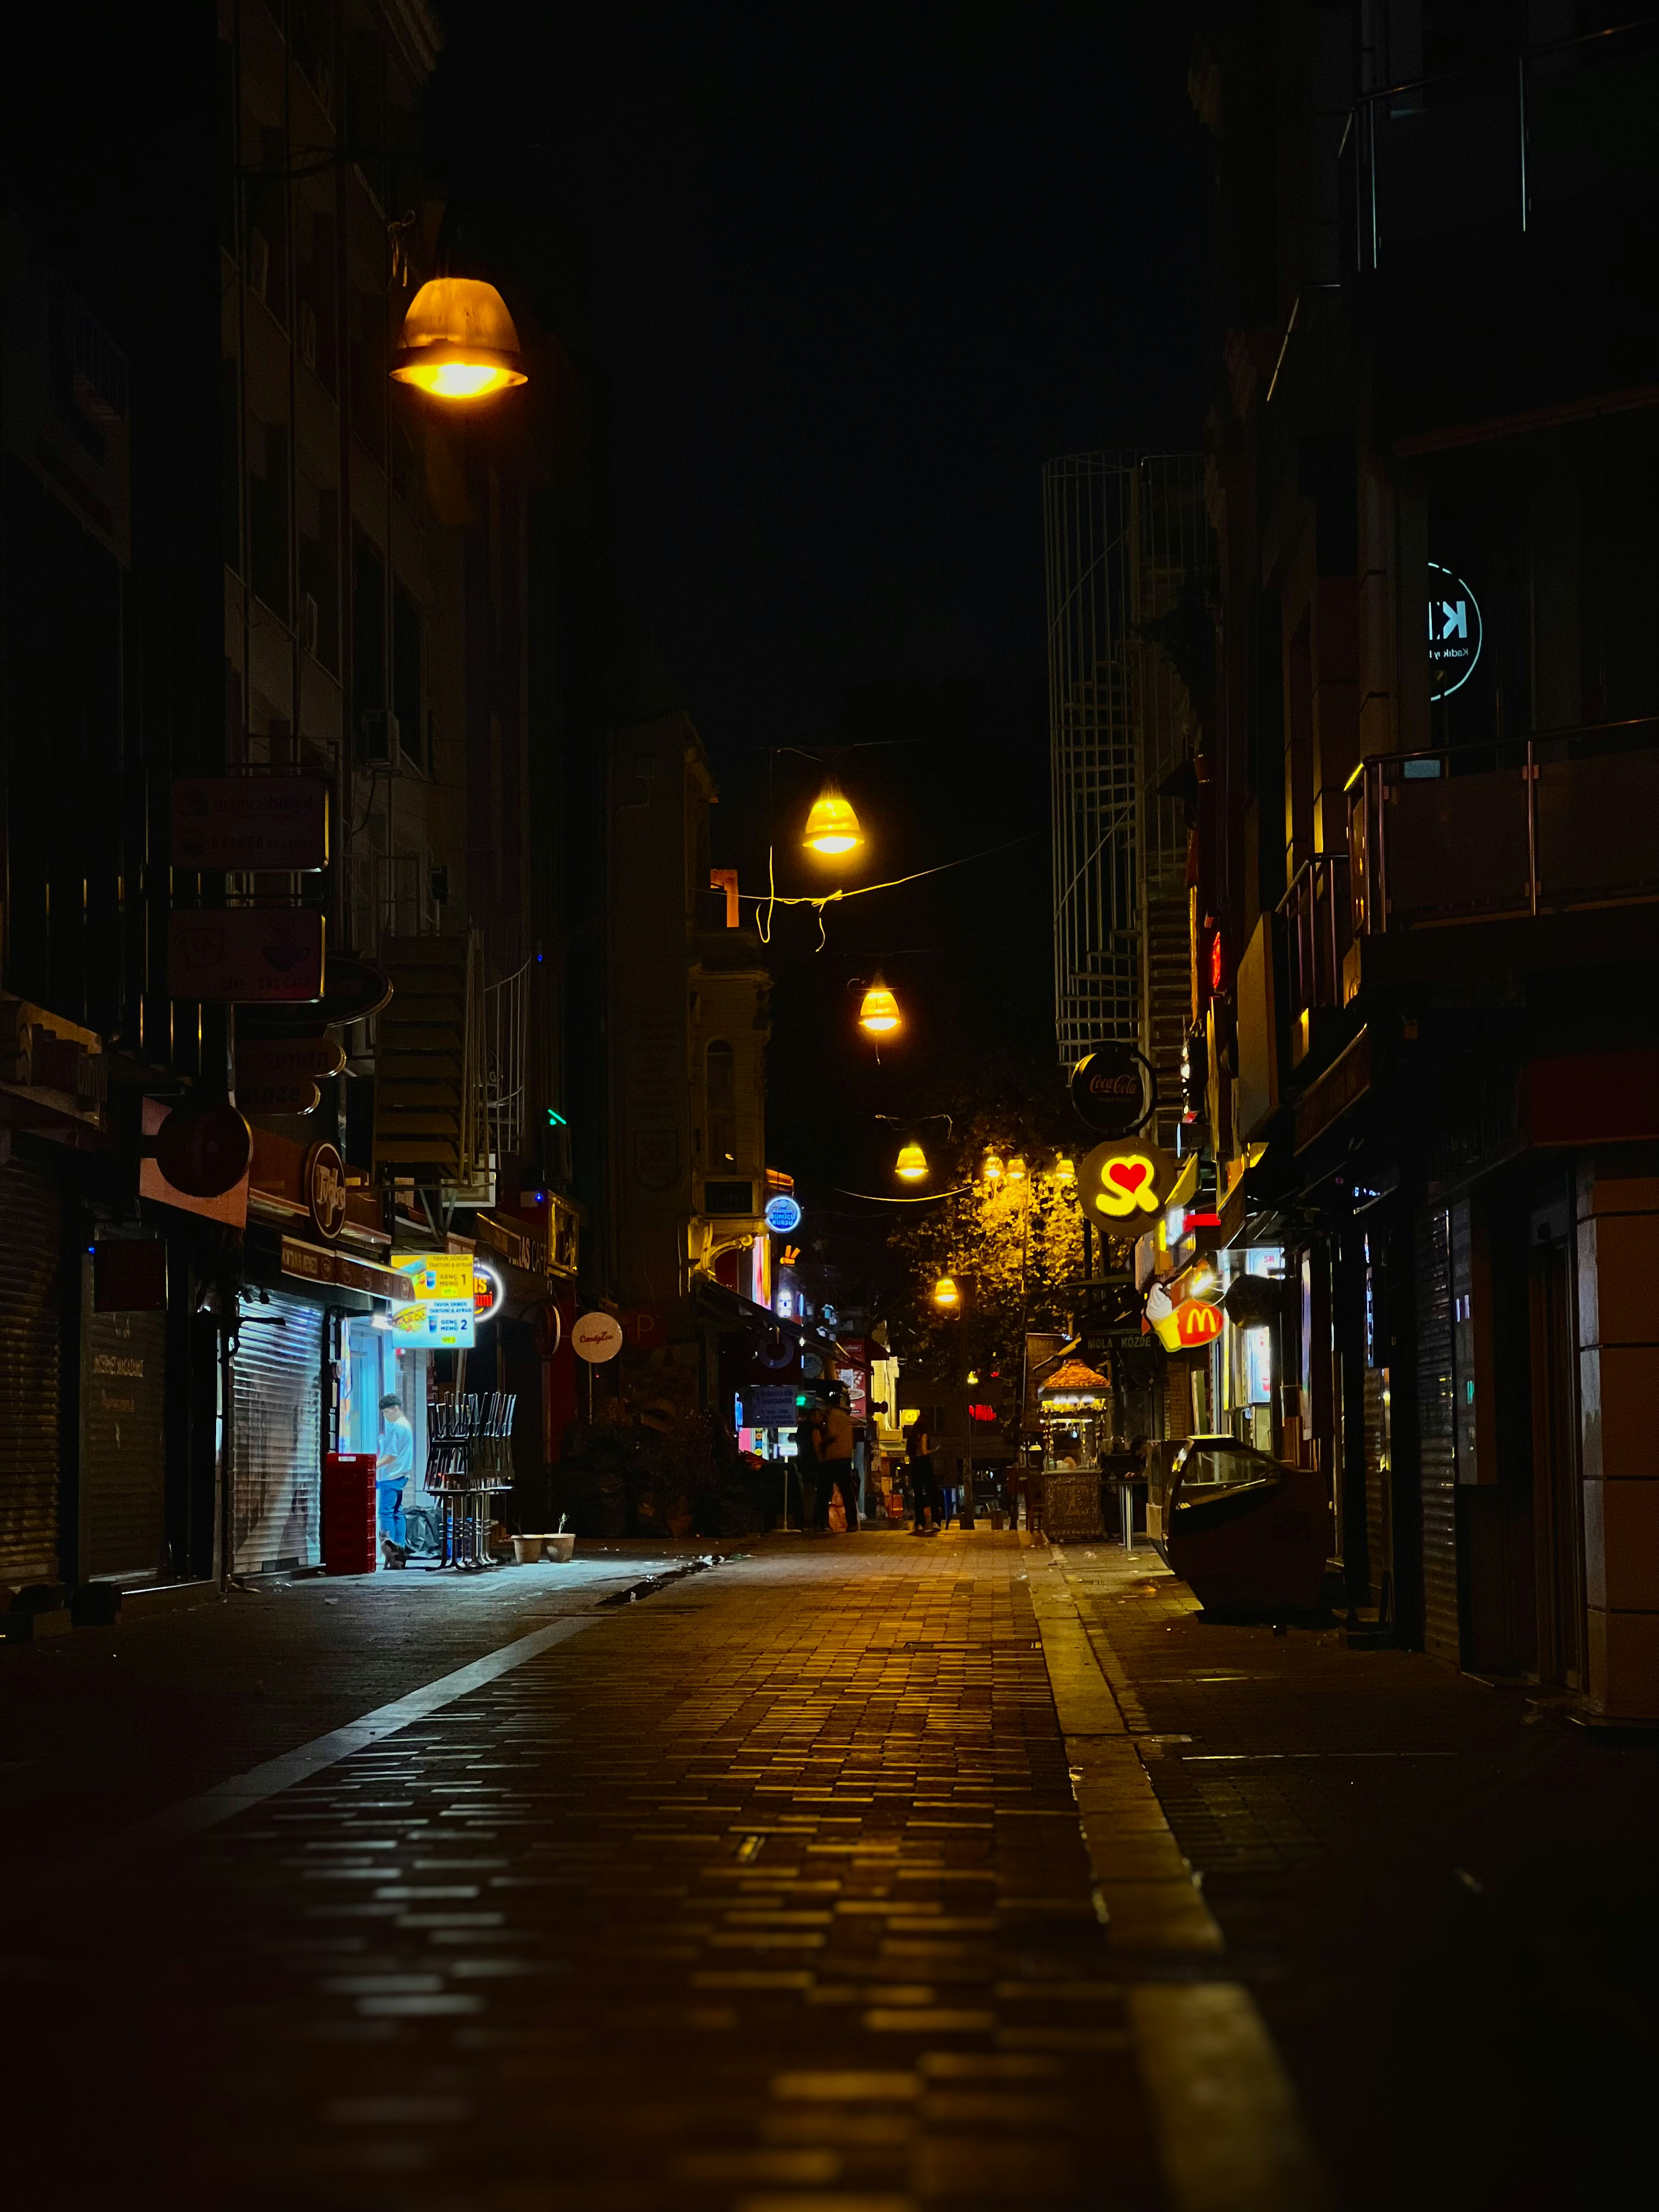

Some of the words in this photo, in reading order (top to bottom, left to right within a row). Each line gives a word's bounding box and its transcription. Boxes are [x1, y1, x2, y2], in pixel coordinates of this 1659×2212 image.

[1090, 1074, 1137, 1094] Coca-Cola
[461, 1274, 466, 1285] 1
[460, 1319, 467, 1330] 2
[1087, 1338, 1113, 1349] MOLA
[1121, 1335, 1152, 1348] KÖZDE
